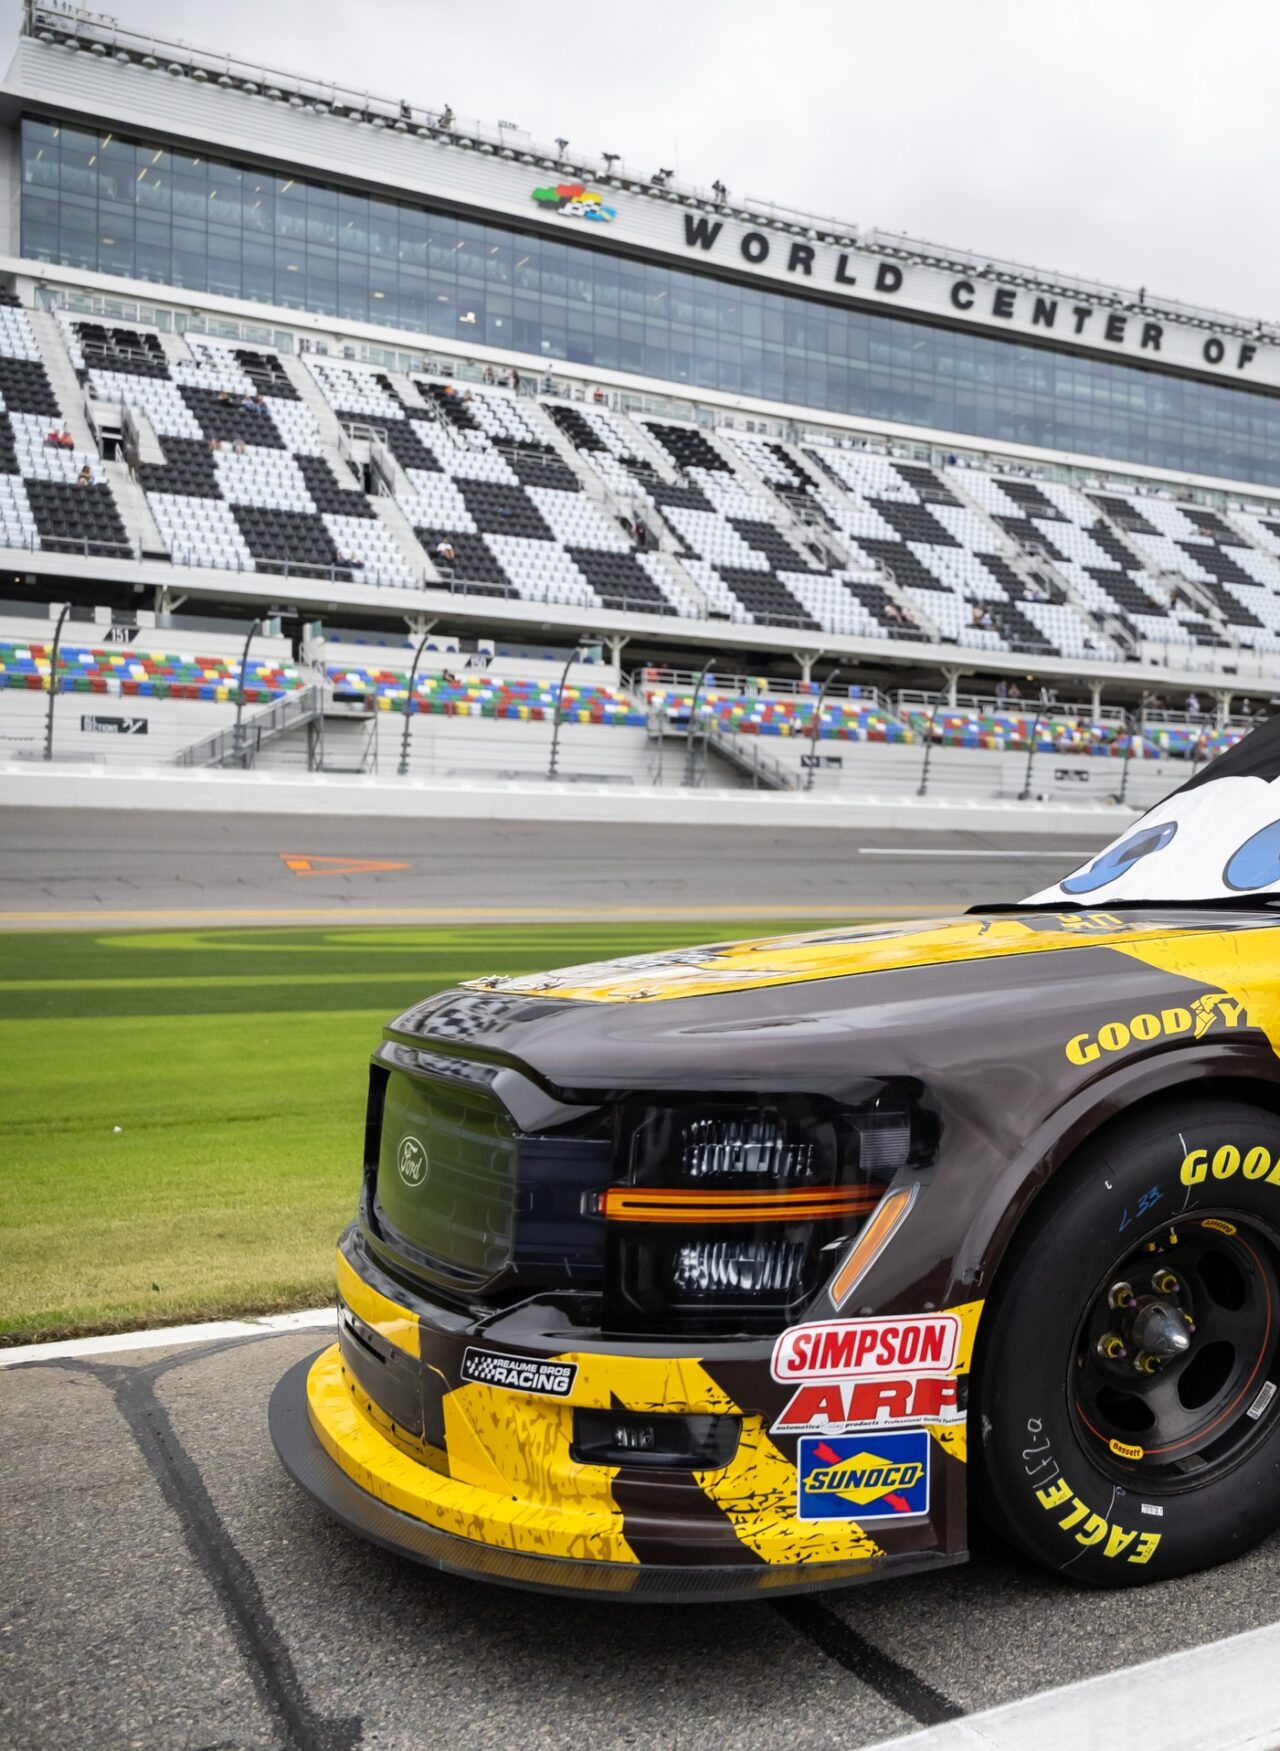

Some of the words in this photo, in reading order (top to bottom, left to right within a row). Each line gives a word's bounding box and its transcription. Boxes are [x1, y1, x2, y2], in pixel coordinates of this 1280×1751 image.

[684, 213, 904, 293] WORLD
[950, 280, 1164, 352] CENTER
[1203, 338, 1257, 370] OF
[111, 627, 130, 642] 151
[400, 1141, 423, 1181] Ford
[787, 1325, 947, 1372] SIMPSON
[494, 1368, 571, 1392] RACING
[497, 1359, 538, 1373] REAUME
[540, 1365, 571, 1377] BROS
[779, 1379, 958, 1425] ARP
[1112, 1442, 1141, 1457] Bassett
[809, 1466, 918, 1491] SUNOCO
[1036, 1477, 1162, 1564] EAGLE
